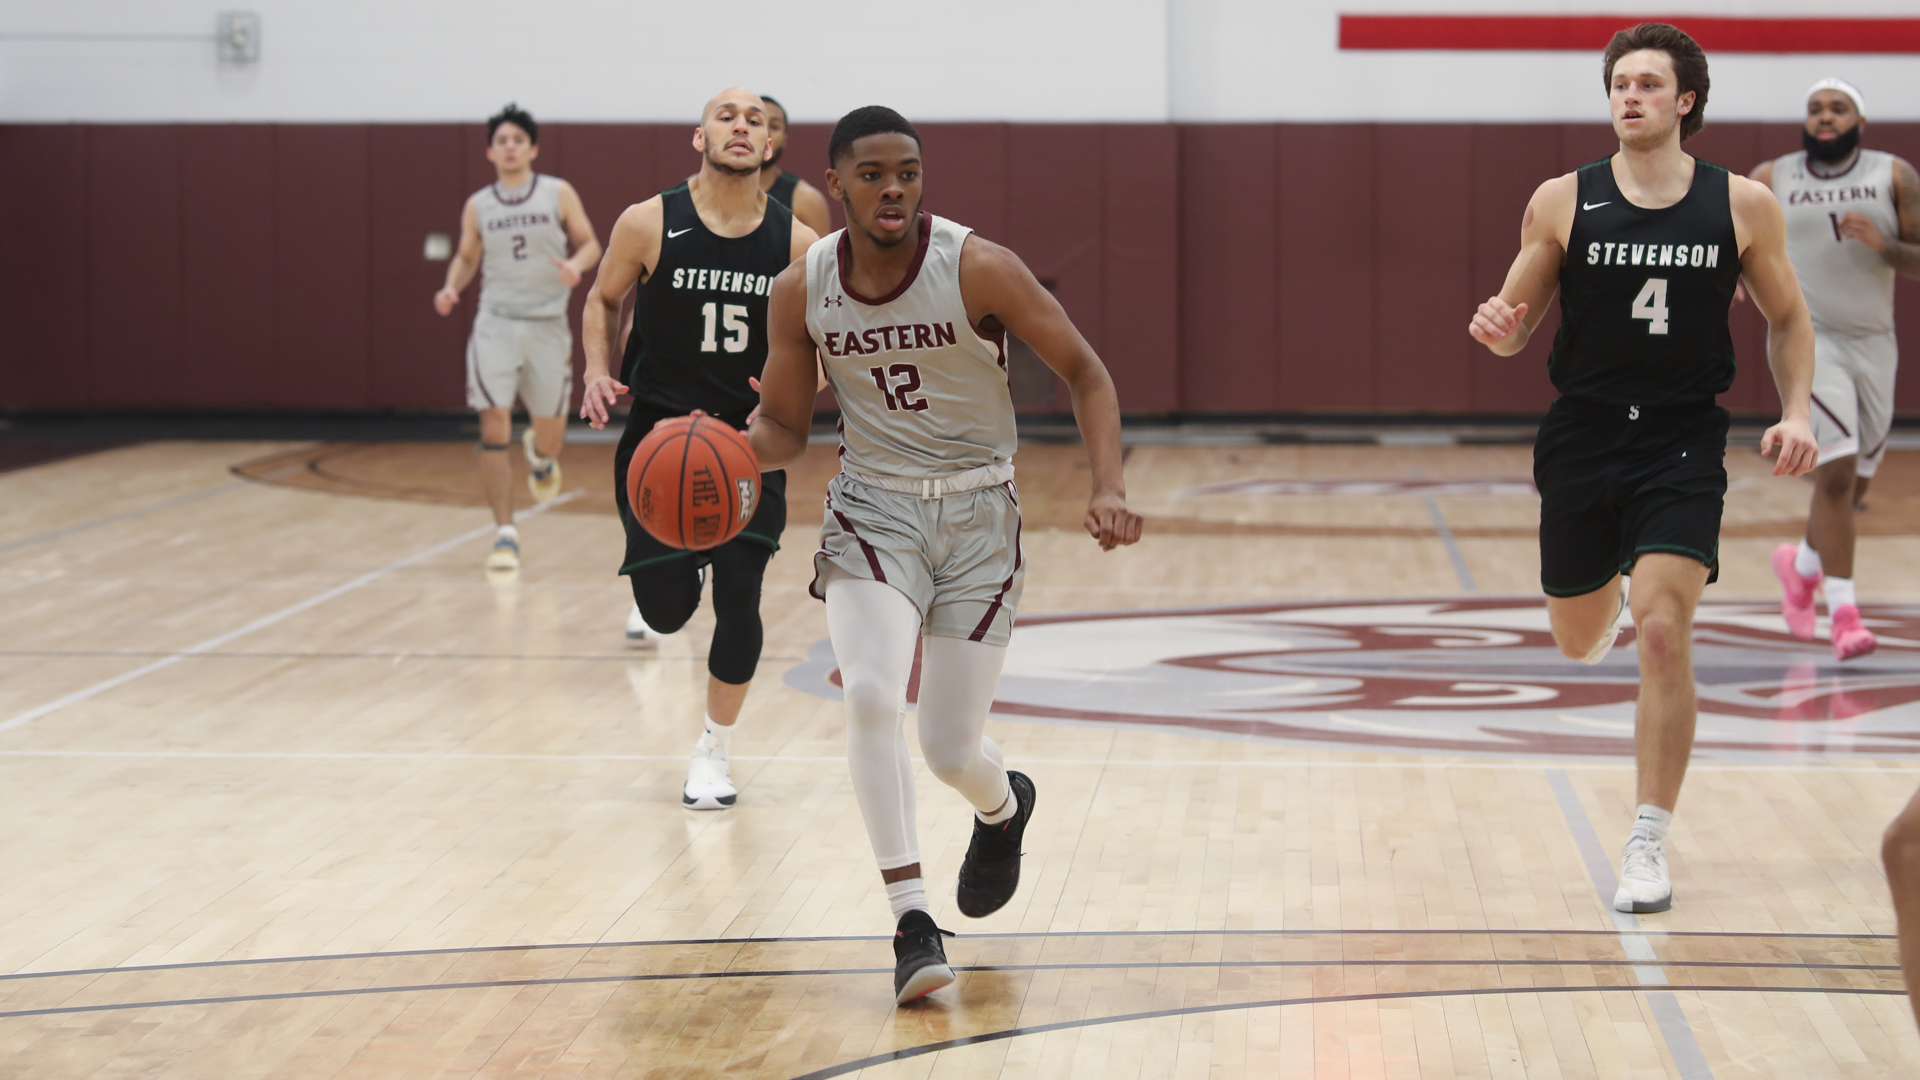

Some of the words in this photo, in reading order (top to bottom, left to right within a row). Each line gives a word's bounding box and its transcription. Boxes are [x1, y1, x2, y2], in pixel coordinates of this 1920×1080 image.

[1789, 186, 1876, 205] EASTERN
[487, 213, 549, 232] EASTERN
[512, 234, 527, 261] 2
[1587, 241, 1719, 268] STEVENSON
[1631, 277, 1669, 335] 4
[700, 302, 749, 353] 15
[823, 321, 957, 358] EASTERN
[869, 363, 929, 412] 12
[692, 465, 720, 507] THE
